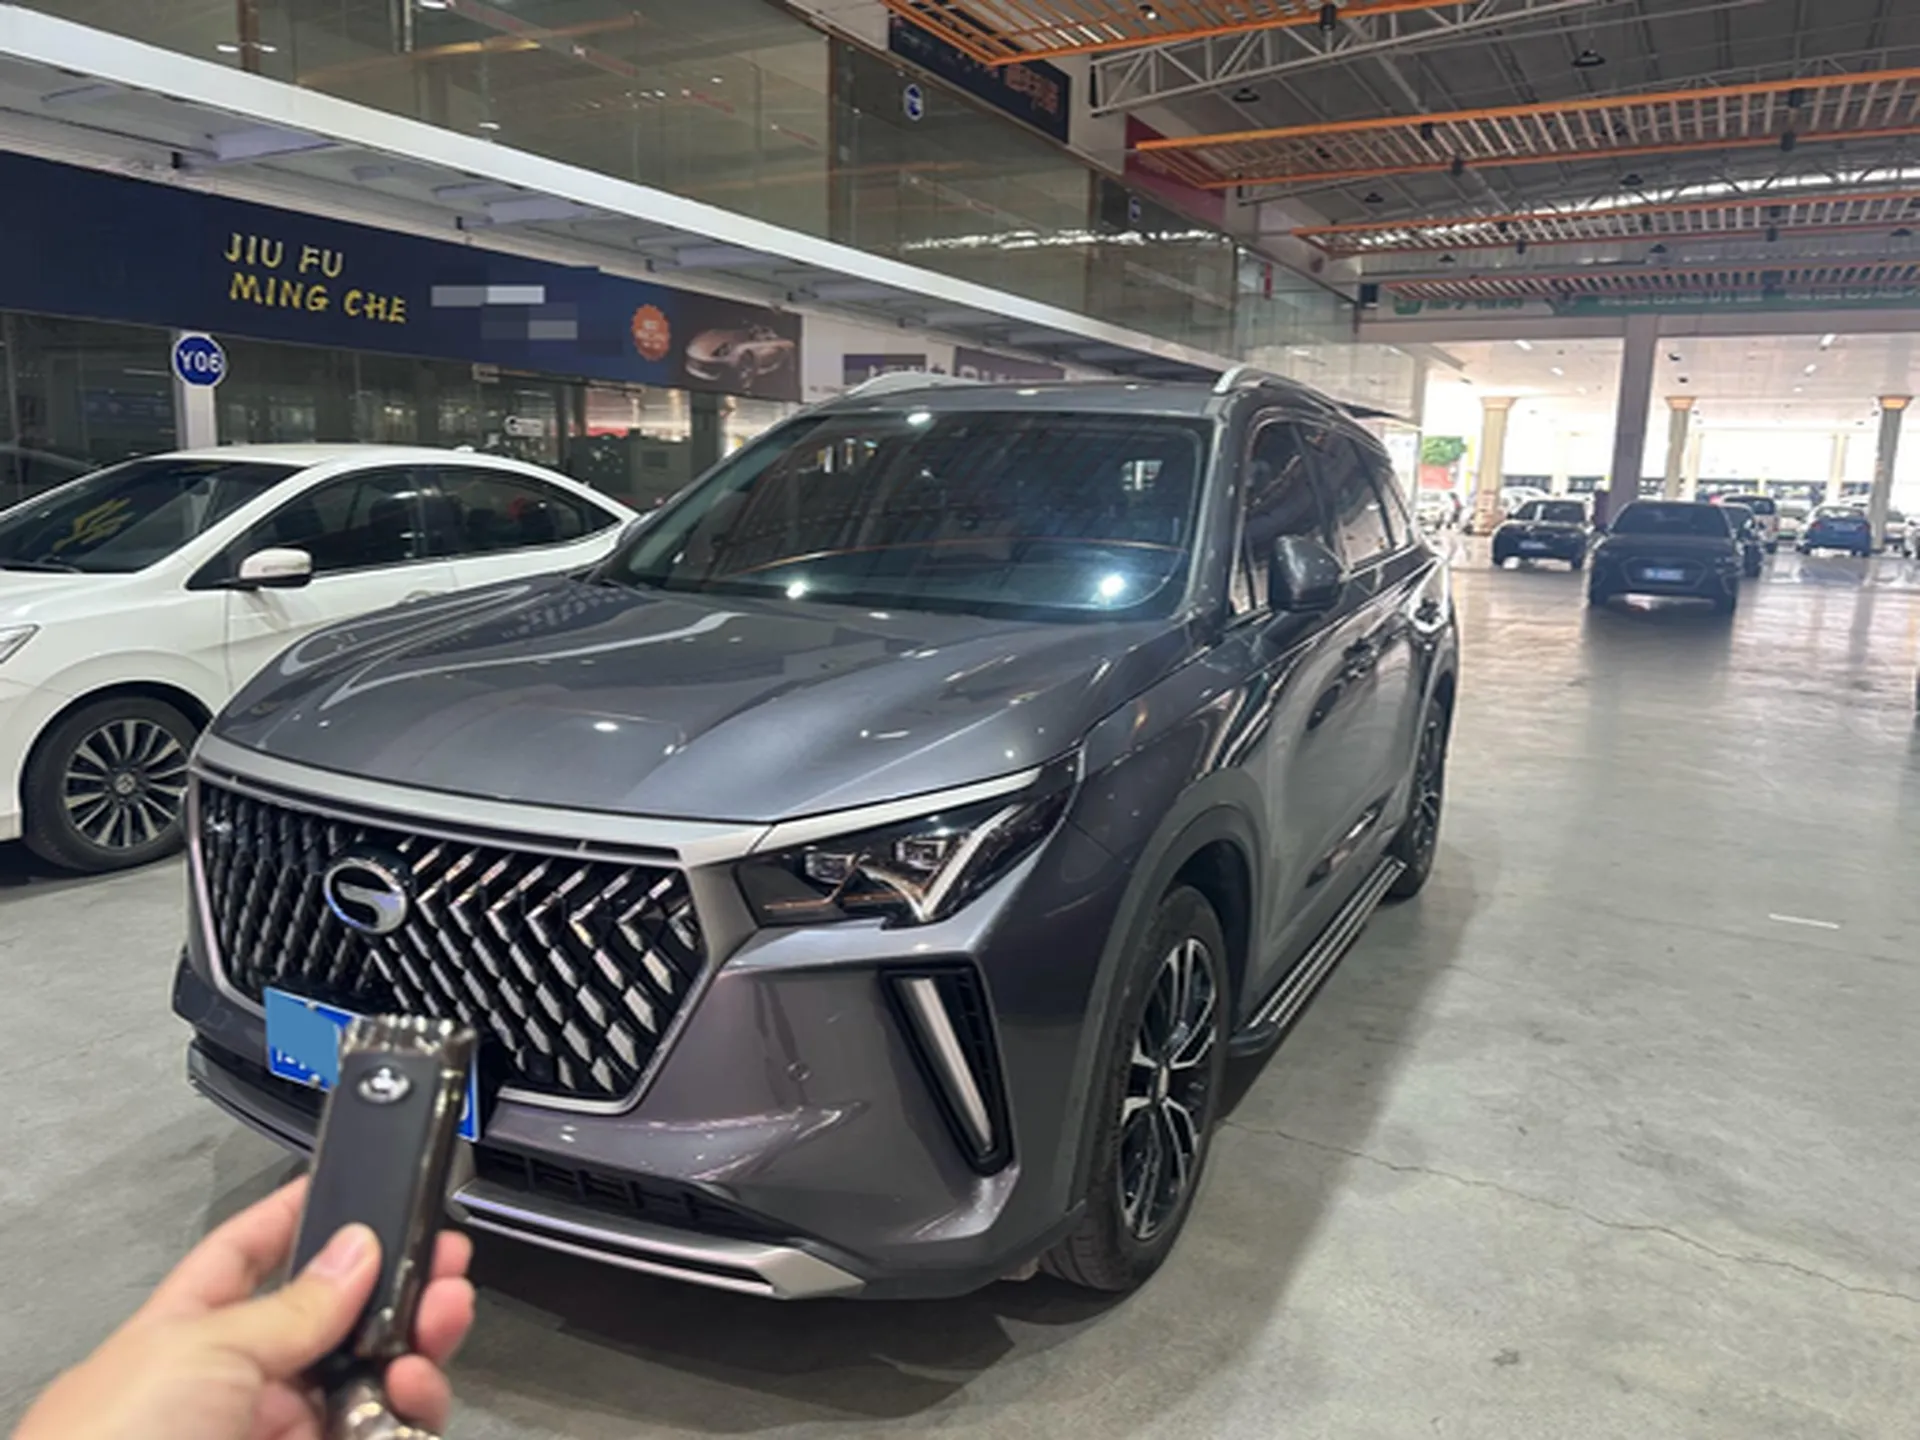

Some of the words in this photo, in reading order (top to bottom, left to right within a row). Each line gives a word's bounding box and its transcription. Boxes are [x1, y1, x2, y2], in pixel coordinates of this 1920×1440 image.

[224, 232, 283, 268] JIU
[299, 245, 344, 278] FU
[229, 271, 329, 311] MING
[344, 289, 407, 323] CHE
[179, 350, 223, 373] Y06
